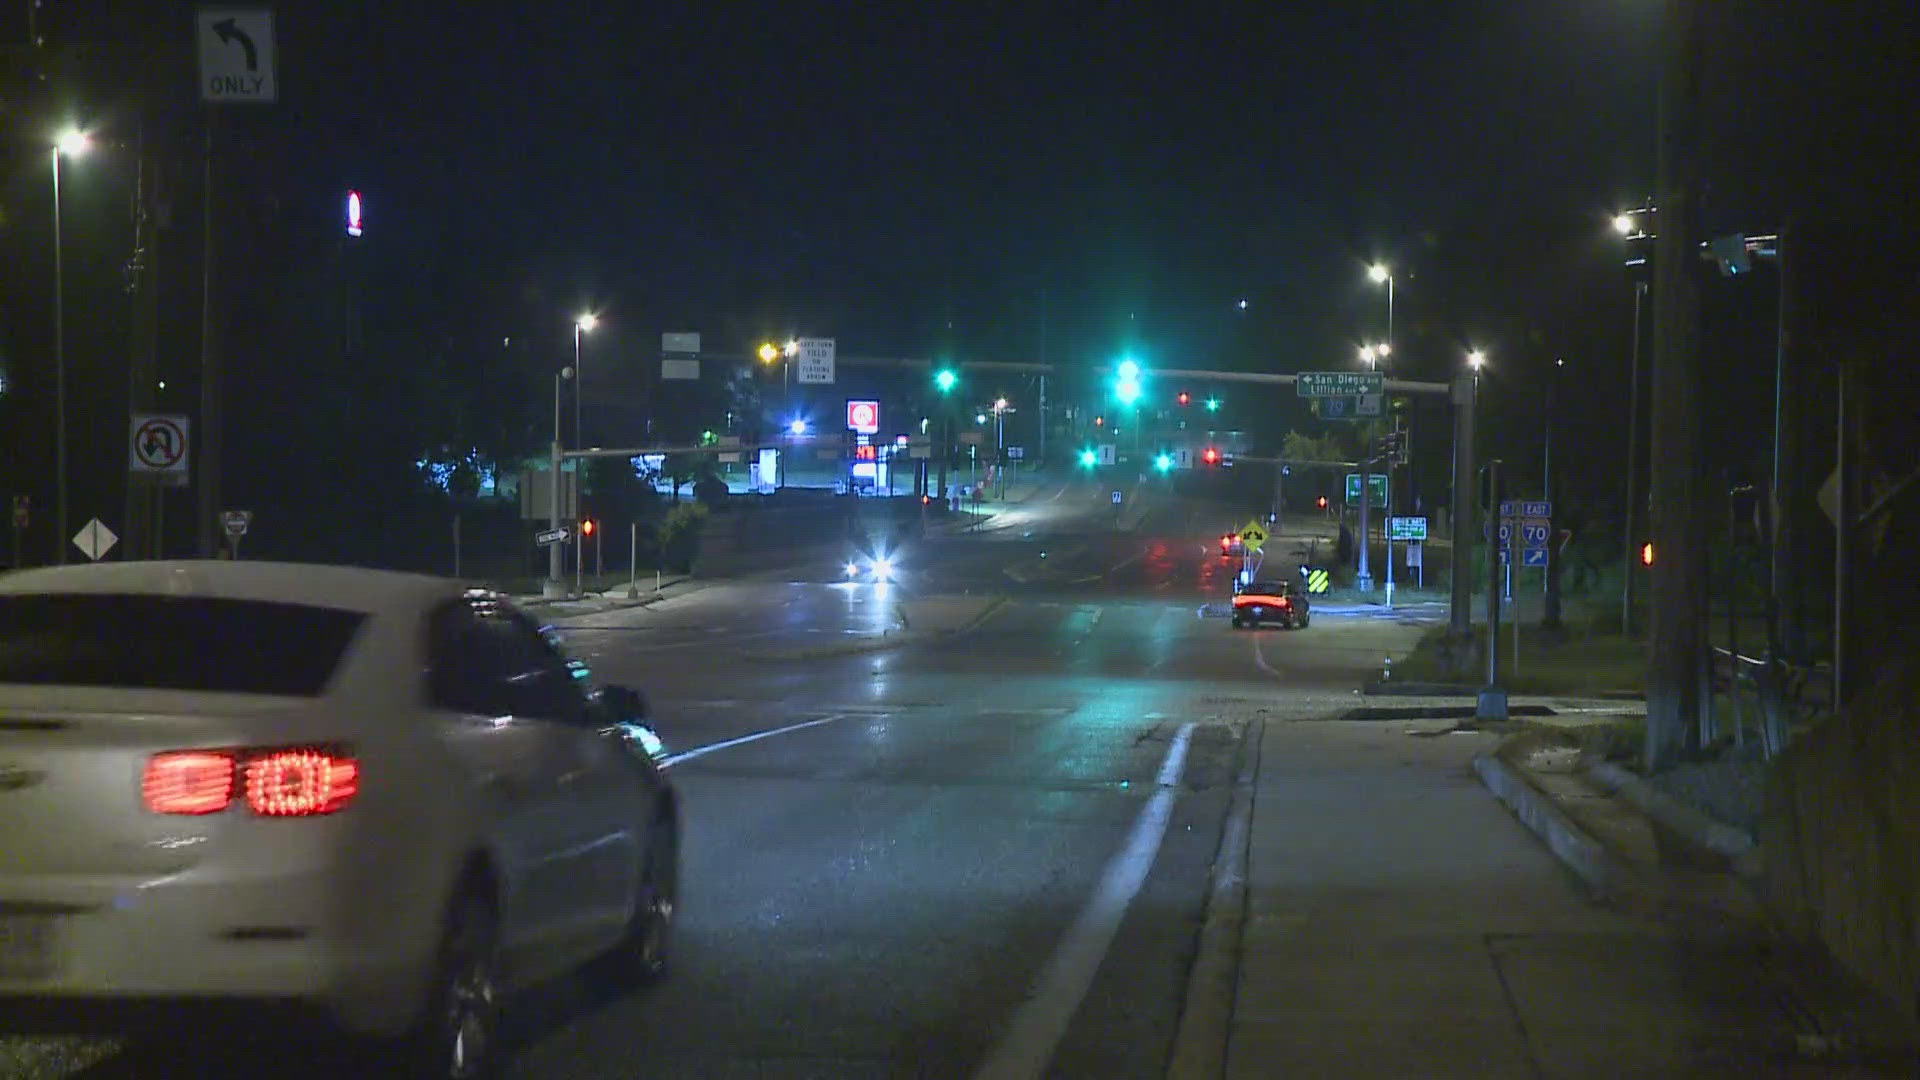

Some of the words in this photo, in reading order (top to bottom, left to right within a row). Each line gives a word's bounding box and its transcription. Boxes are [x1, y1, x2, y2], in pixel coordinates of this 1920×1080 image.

[210, 76, 264, 95] ONLY
[1315, 375, 1332, 384] San
[1338, 374, 1365, 385] Diego
[1311, 385, 1343, 393] Lillian
[1526, 504, 1546, 515] EAST
[1526, 527, 1546, 540] 70
